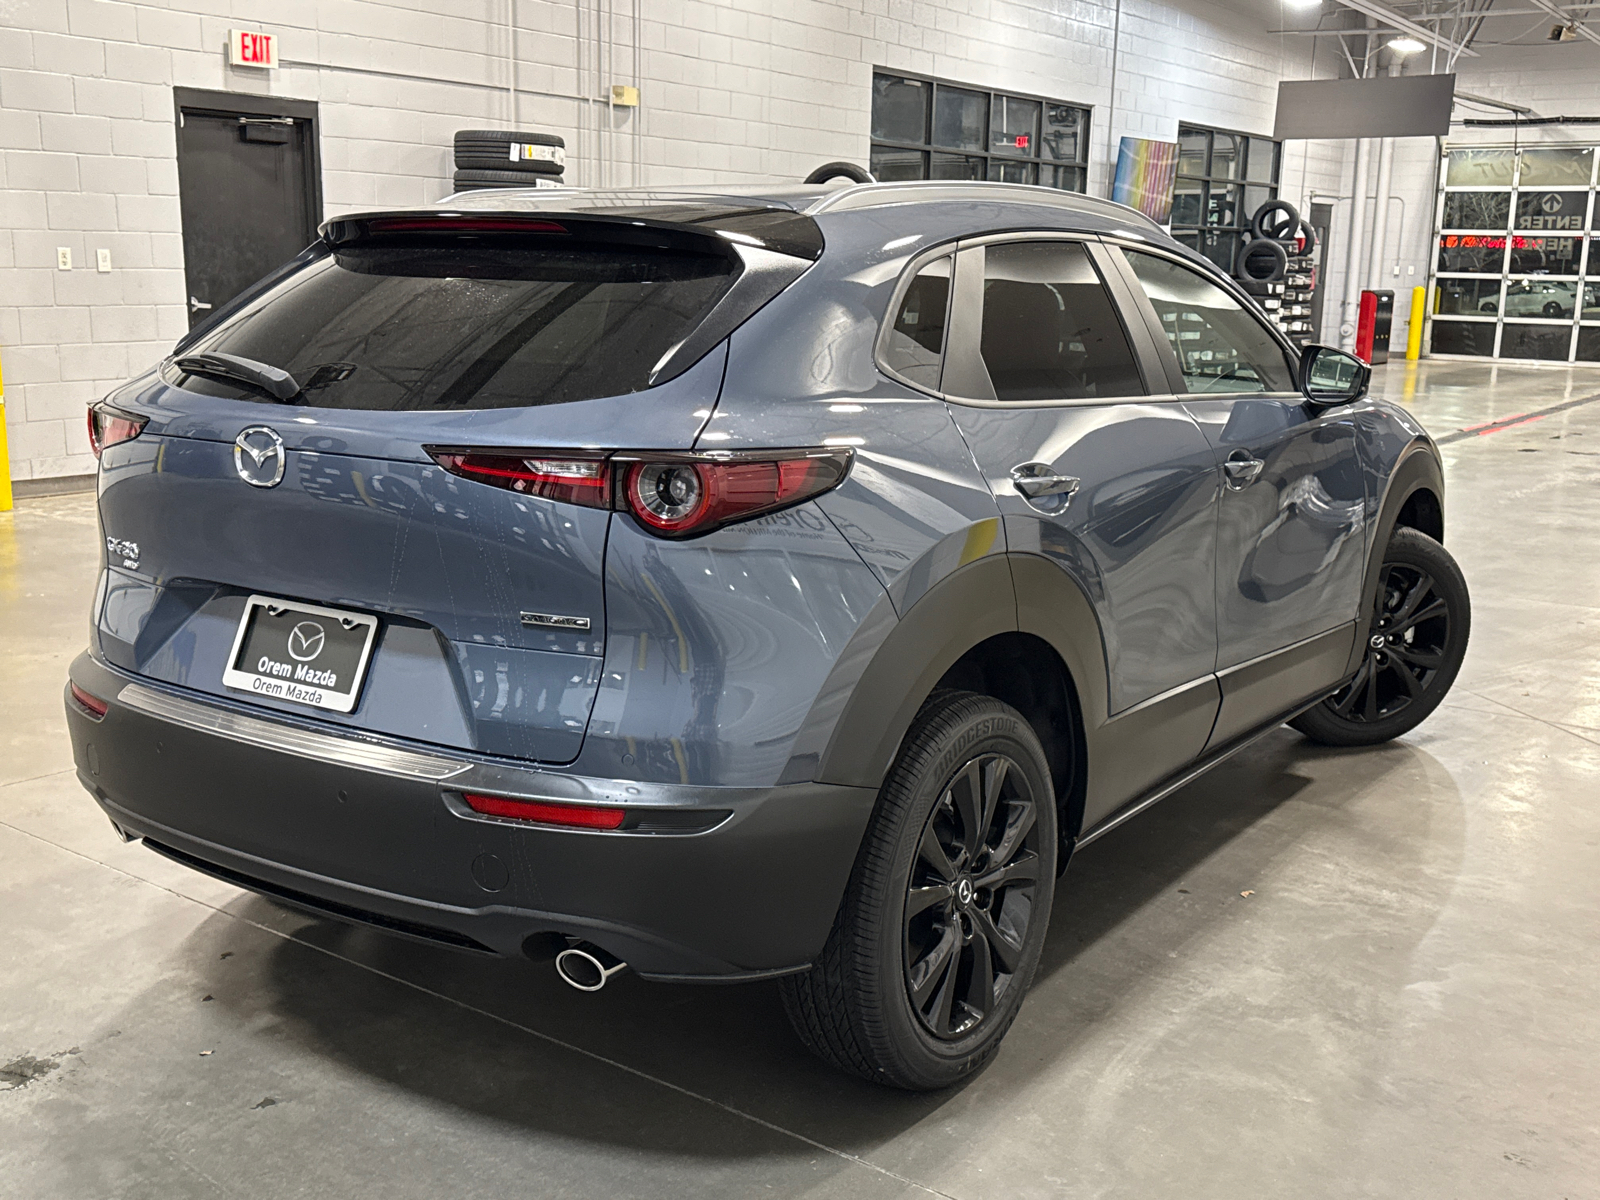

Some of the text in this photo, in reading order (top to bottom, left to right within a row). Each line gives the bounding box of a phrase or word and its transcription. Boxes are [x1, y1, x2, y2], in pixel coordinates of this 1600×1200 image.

[241, 32, 271, 64] EXIT
[257, 655, 337, 688] Orem Mazda
[252, 677, 322, 704] Orem Mazda
[932, 716, 1019, 779] BRIDGESTONE
